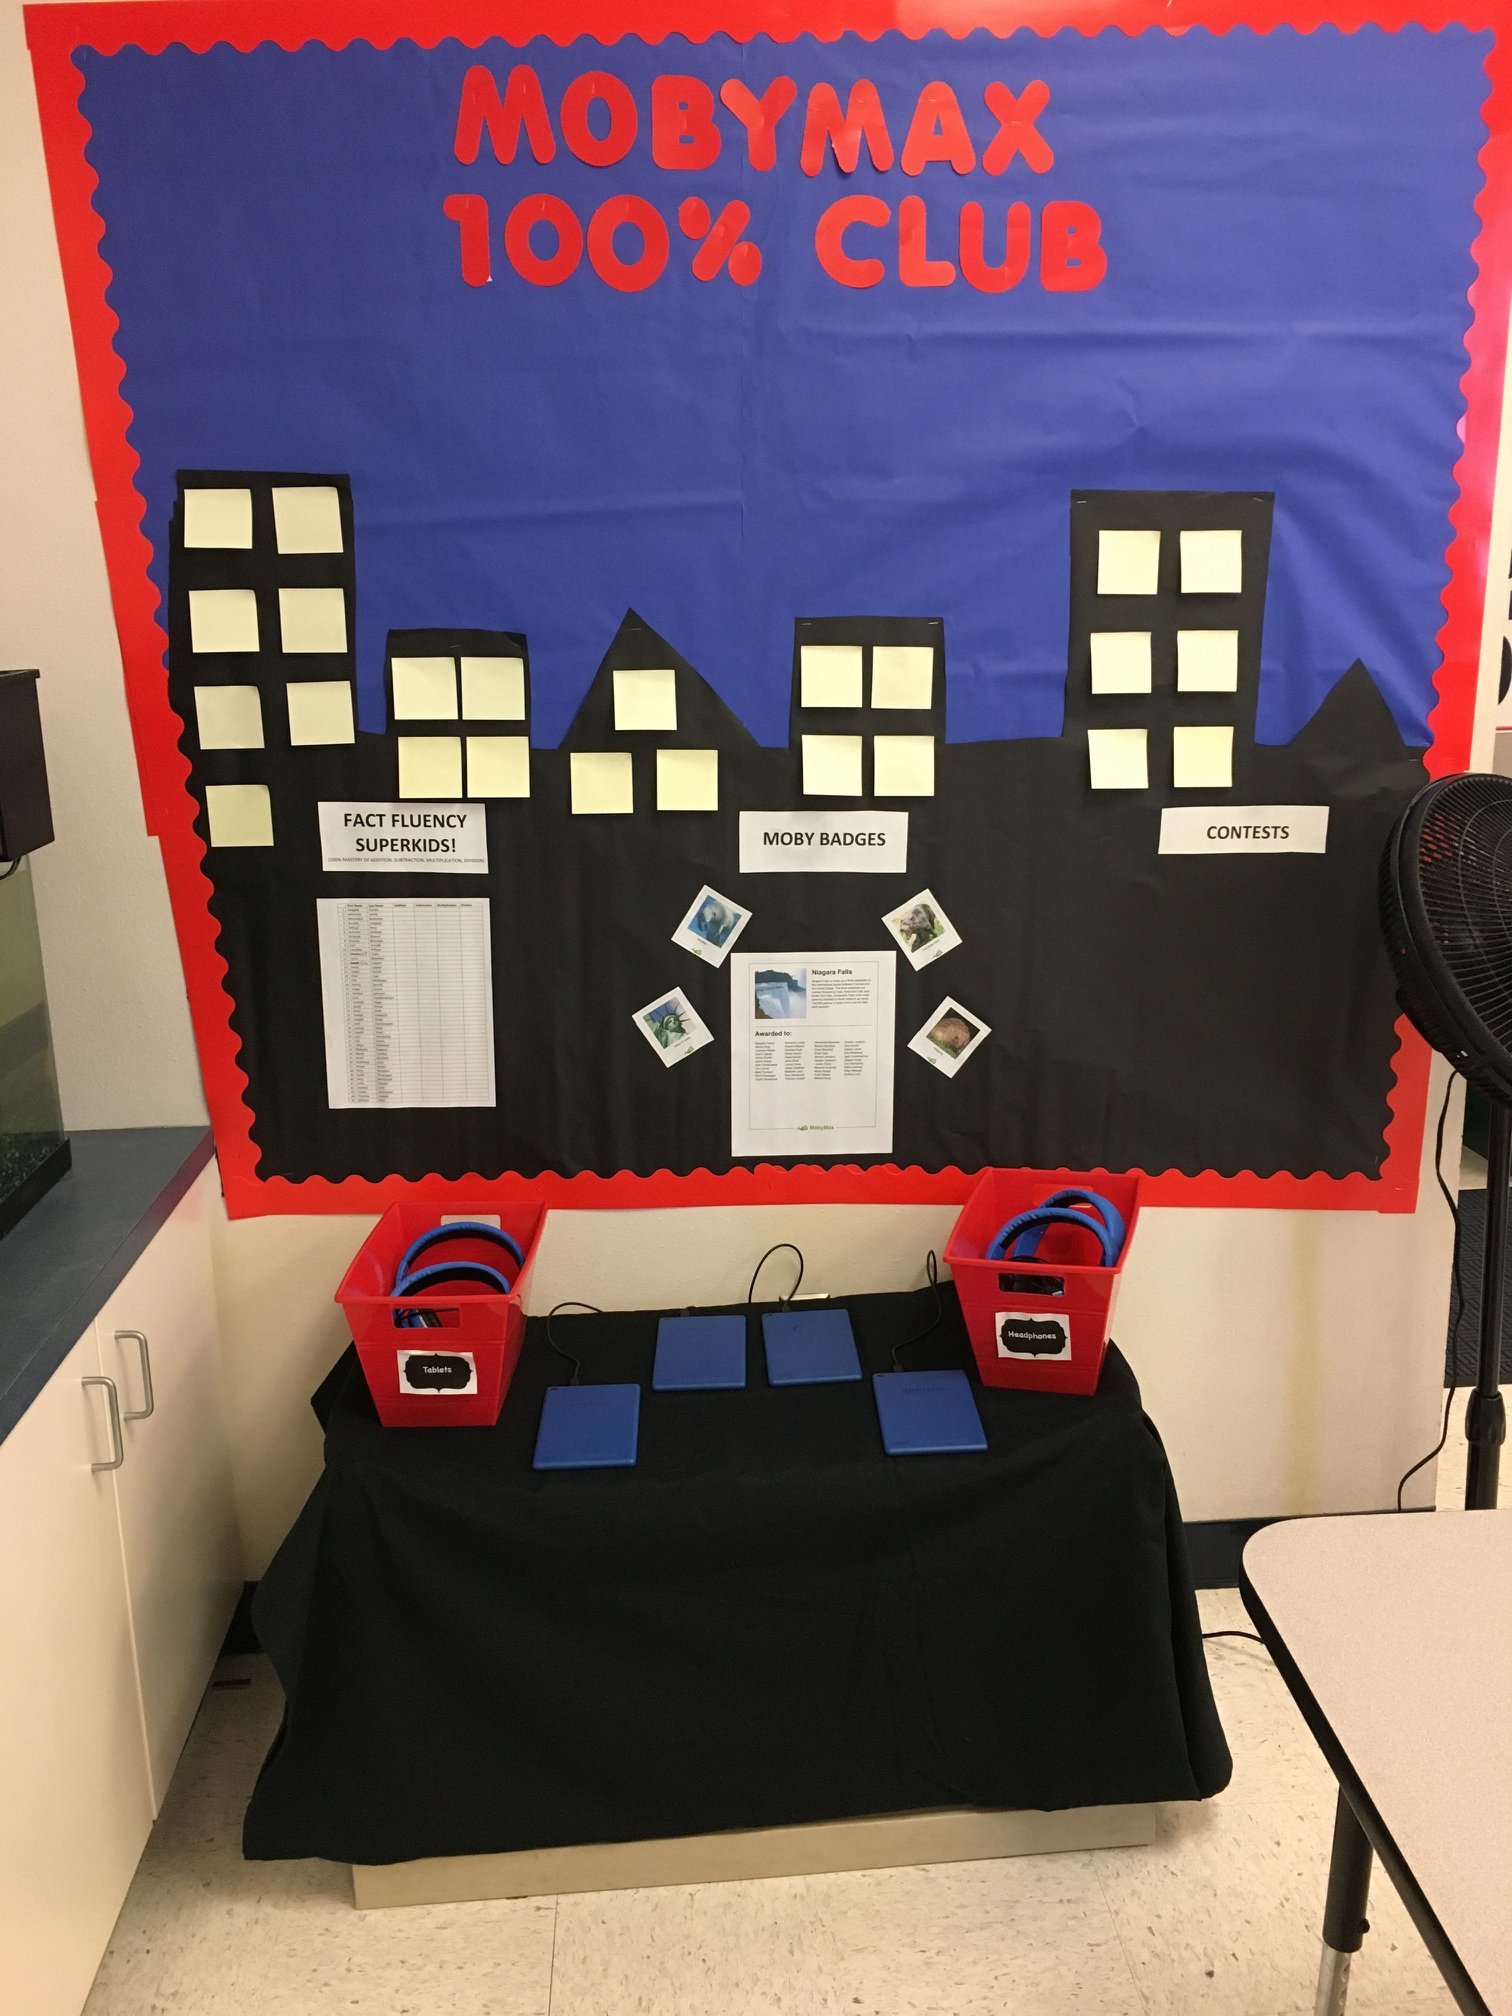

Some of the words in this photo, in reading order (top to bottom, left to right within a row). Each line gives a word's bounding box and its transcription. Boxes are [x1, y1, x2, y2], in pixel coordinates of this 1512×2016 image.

[454, 64, 1054, 177] MOBYMAX
[443, 193, 762, 293] 100%
[815, 194, 1108, 293] CLUB
[344, 813, 386, 828] FACT
[391, 814, 467, 829] FLUENCY
[763, 832, 815, 846] MOBY
[820, 832, 886, 846] BADGES
[1207, 825, 1290, 840] CONTESTS
[355, 837, 456, 853] SUPERKIDS!
[1008, 1330, 1057, 1341] Headphones
